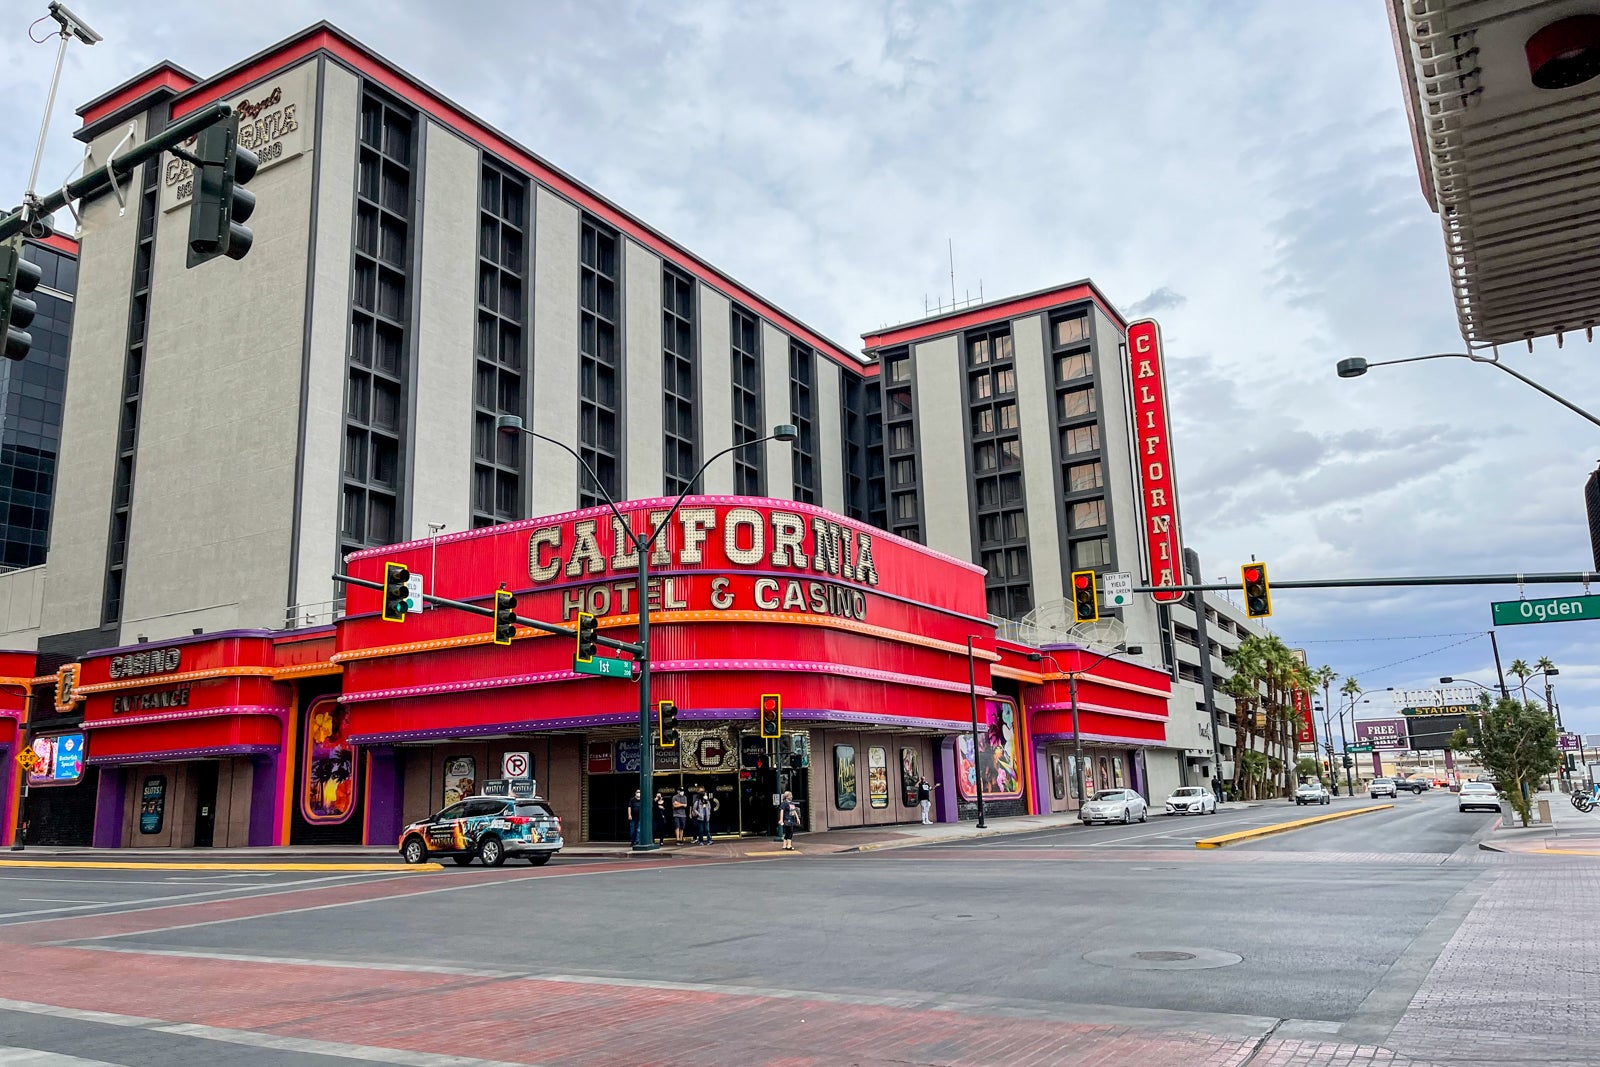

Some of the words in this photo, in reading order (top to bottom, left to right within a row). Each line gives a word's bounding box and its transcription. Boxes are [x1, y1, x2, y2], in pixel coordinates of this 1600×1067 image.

[1136, 335, 1175, 588] CALIFORNIA
[528, 507, 879, 586] CALIFORNIA
[562, 577, 687, 620] HOTEL
[710, 577, 735, 610] &
[754, 577, 867, 621] CASINO
[1494, 604, 1500, 612] E
[1520, 599, 1583, 621] Ogden
[109, 647, 181, 679] CASINO
[599, 659, 610, 673] 1st
[113, 688, 189, 713] ENTRANCE
[1415, 705, 1467, 715] STATION
[1367, 725, 1395, 735] FREE
[700, 739, 721, 767] C
